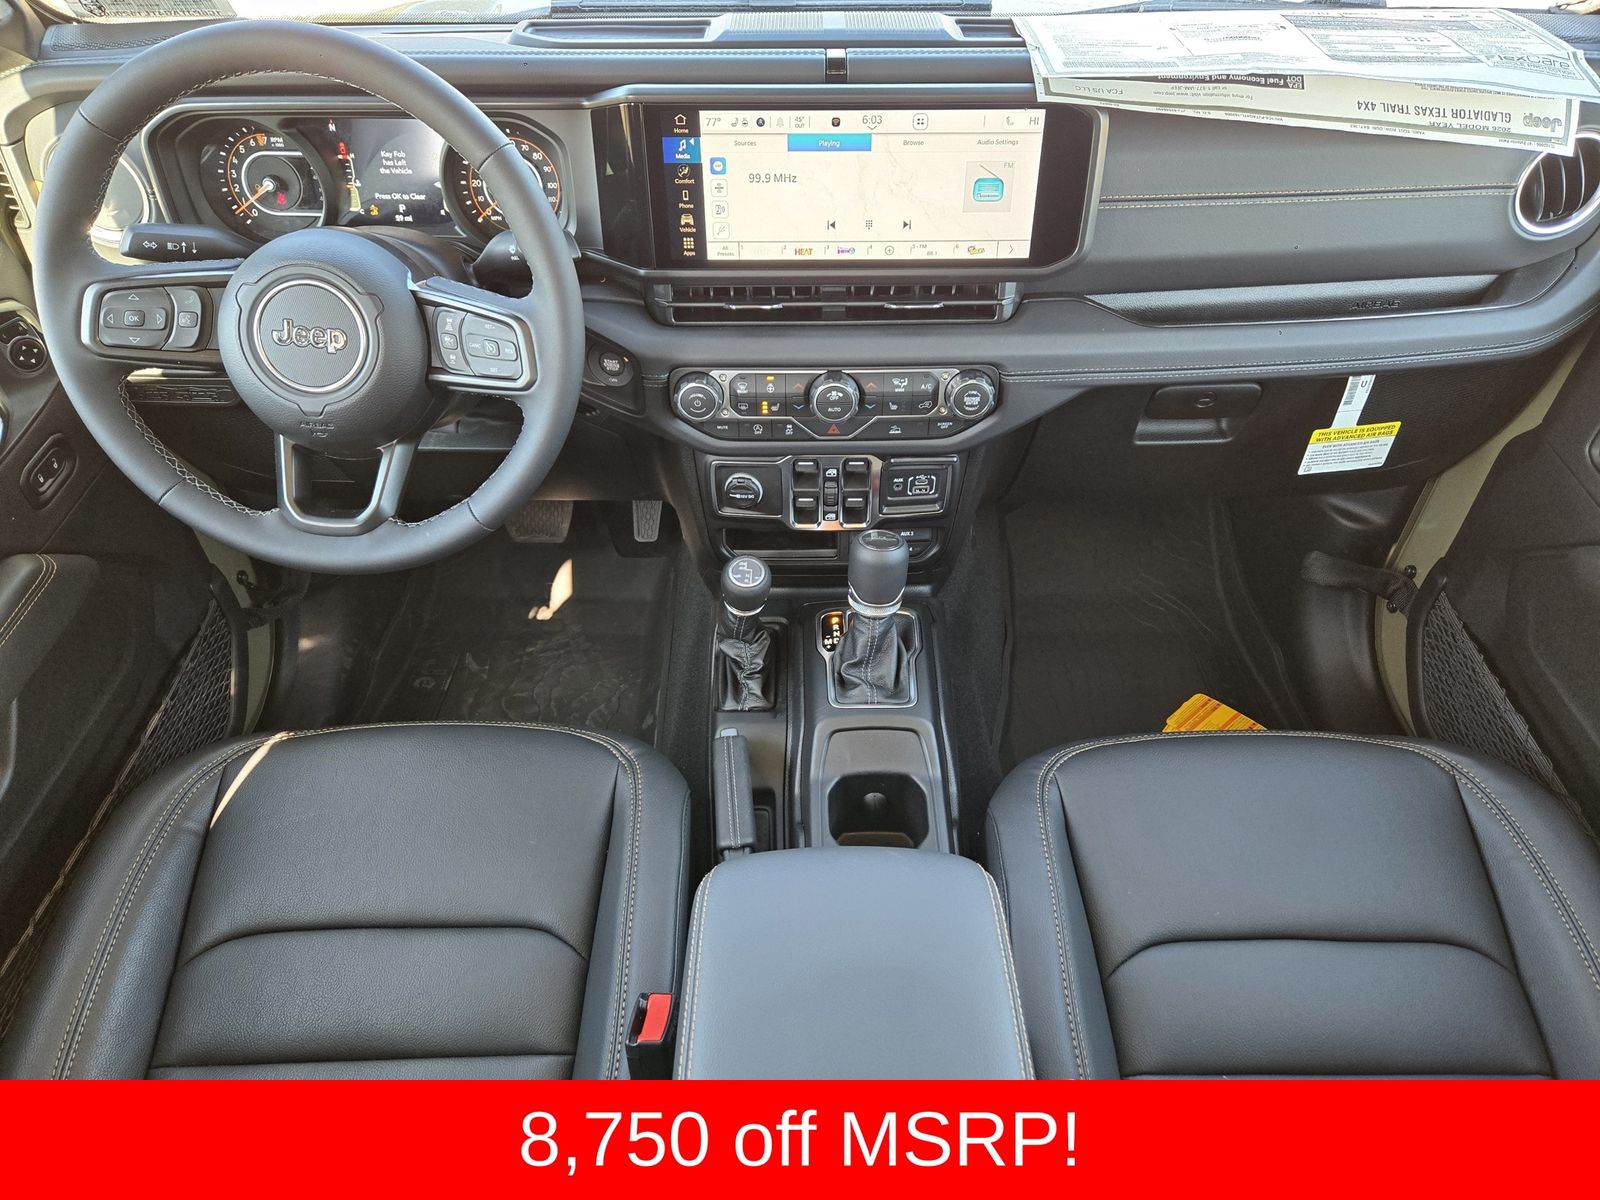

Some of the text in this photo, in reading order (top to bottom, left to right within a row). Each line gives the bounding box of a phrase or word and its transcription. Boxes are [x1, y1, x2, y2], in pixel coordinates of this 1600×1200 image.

[1228, 75, 1265, 84] Economy
[1092, 86, 1104, 94] US
[1356, 99, 1512, 124] GLADIATOR TEXAS TRAIL 4X4
[862, 114, 883, 125] 6:03
[1029, 116, 1040, 126] HI
[1522, 112, 1563, 133] Jeep
[328, 123, 336, 132] N
[1428, 120, 1512, 133] 2026 MODEL YEAR
[249, 139, 256, 147] 6
[818, 139, 841, 148] Playing
[239, 145, 245, 153] 5
[380, 150, 406, 159] Key Fob
[532, 152, 543, 160] 80
[232, 156, 239, 164] 4
[231, 169, 237, 177] 3
[391, 167, 413, 175] Vehicle
[748, 172, 798, 183] 99.9 MHz
[471, 179, 482, 187] 20
[233, 184, 240, 192] 2
[375, 192, 392, 200] Press
[392, 192, 402, 200] OK
[410, 192, 426, 200] Clear
[251, 208, 258, 217] 0
[398, 204, 406, 213] P
[794, 248, 813, 256] HEAT
[271, 318, 348, 355] Jeep
[1333, 427, 1358, 436] VEHICLE
[1365, 424, 1396, 433] EQUIPPED
[1315, 435, 1333, 443] WITH
[1332, 432, 1365, 442] ADVANCED
